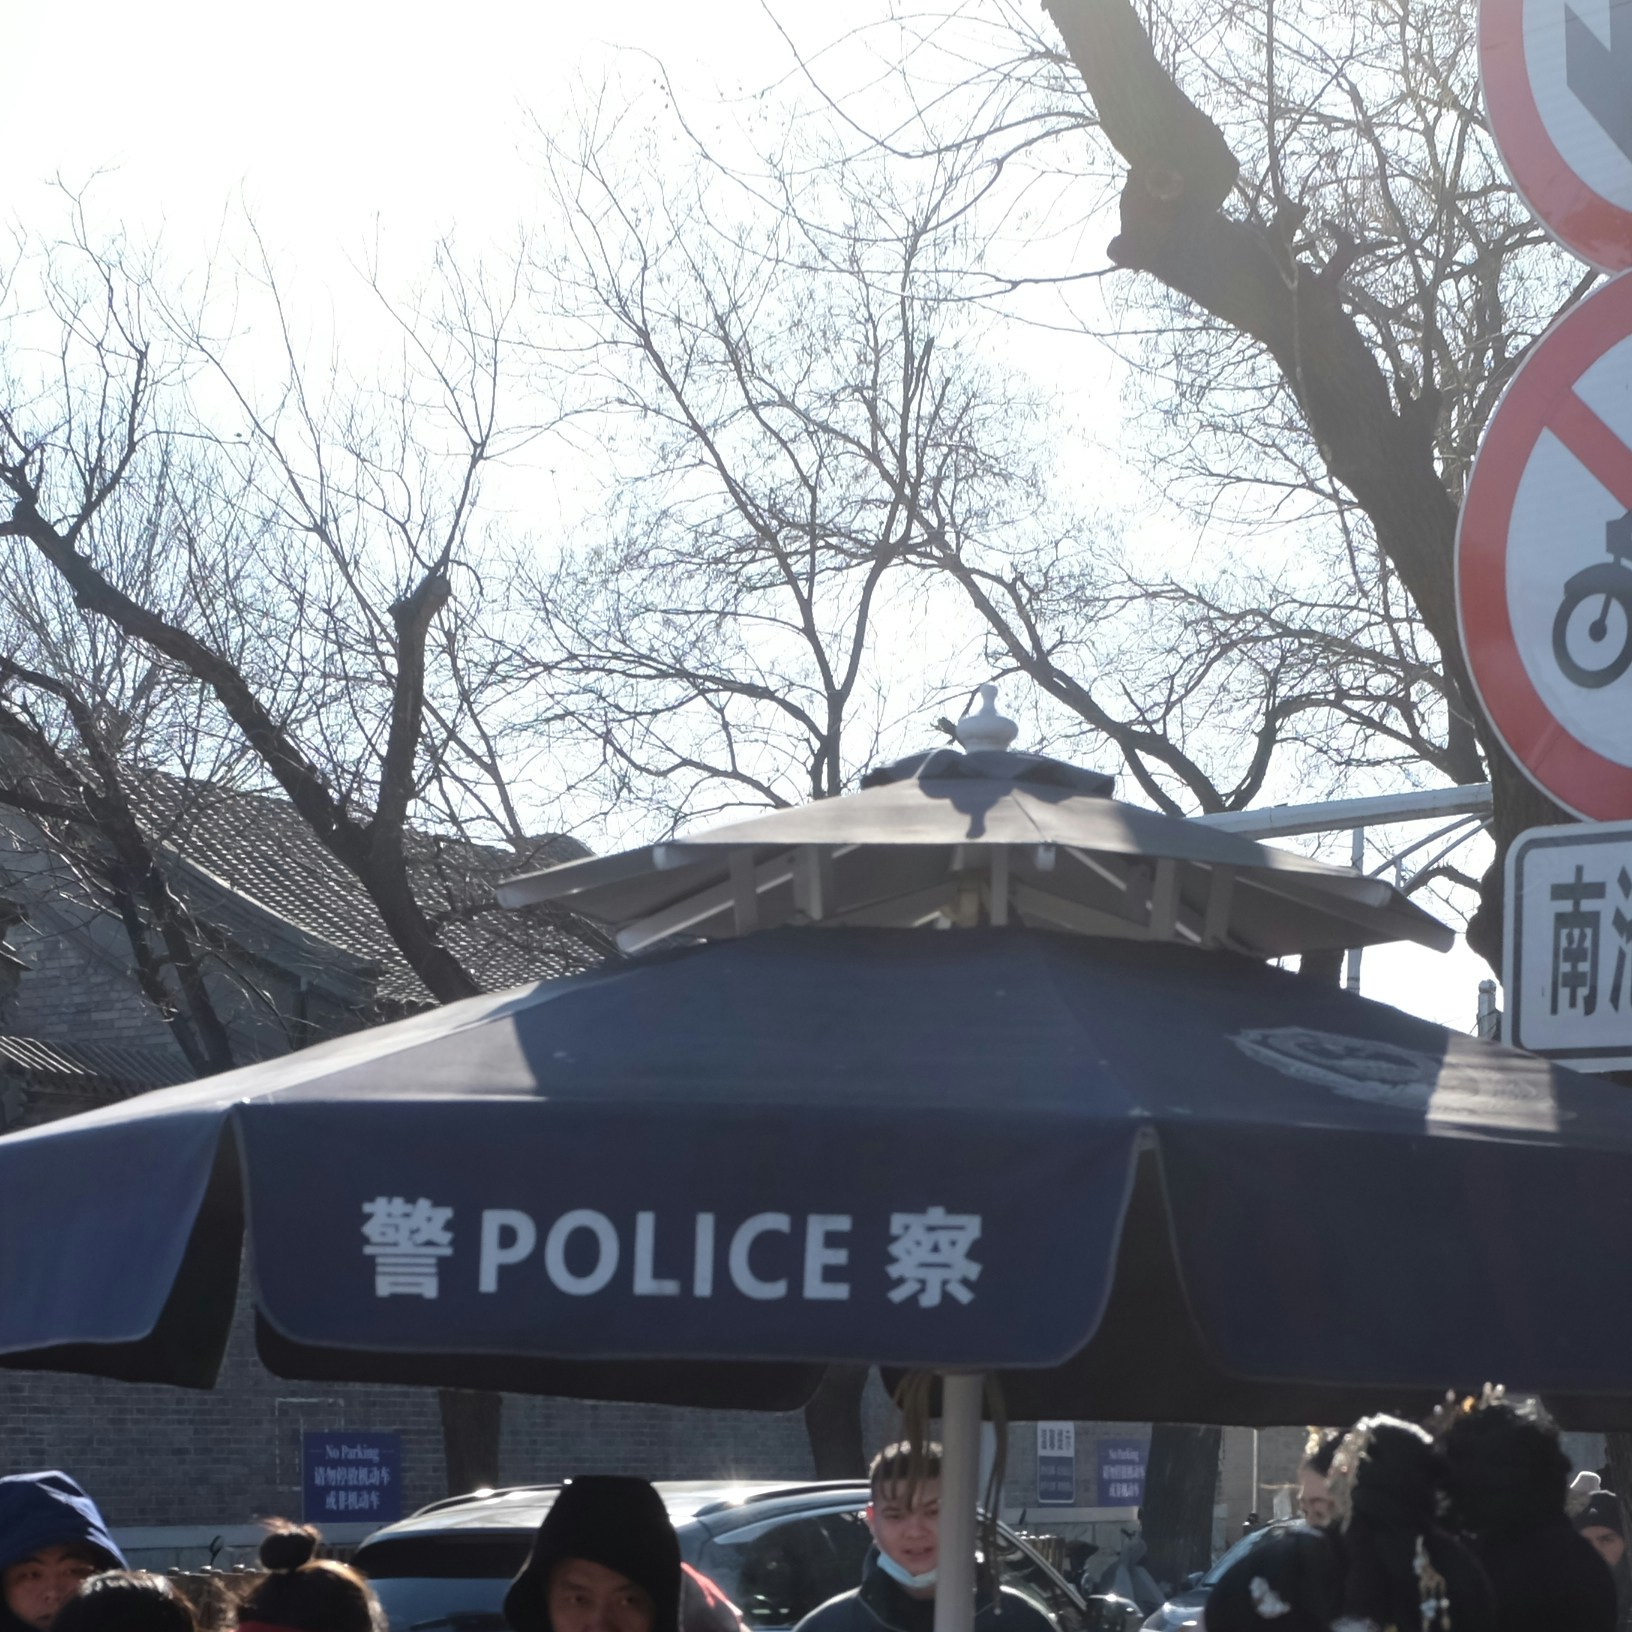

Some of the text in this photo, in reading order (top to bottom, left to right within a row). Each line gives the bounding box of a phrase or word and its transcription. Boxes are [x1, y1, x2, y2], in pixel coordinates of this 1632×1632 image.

[362, 1197, 983, 1308] 警 POLICE 察
[325, 1443, 380, 1463] No Parking
